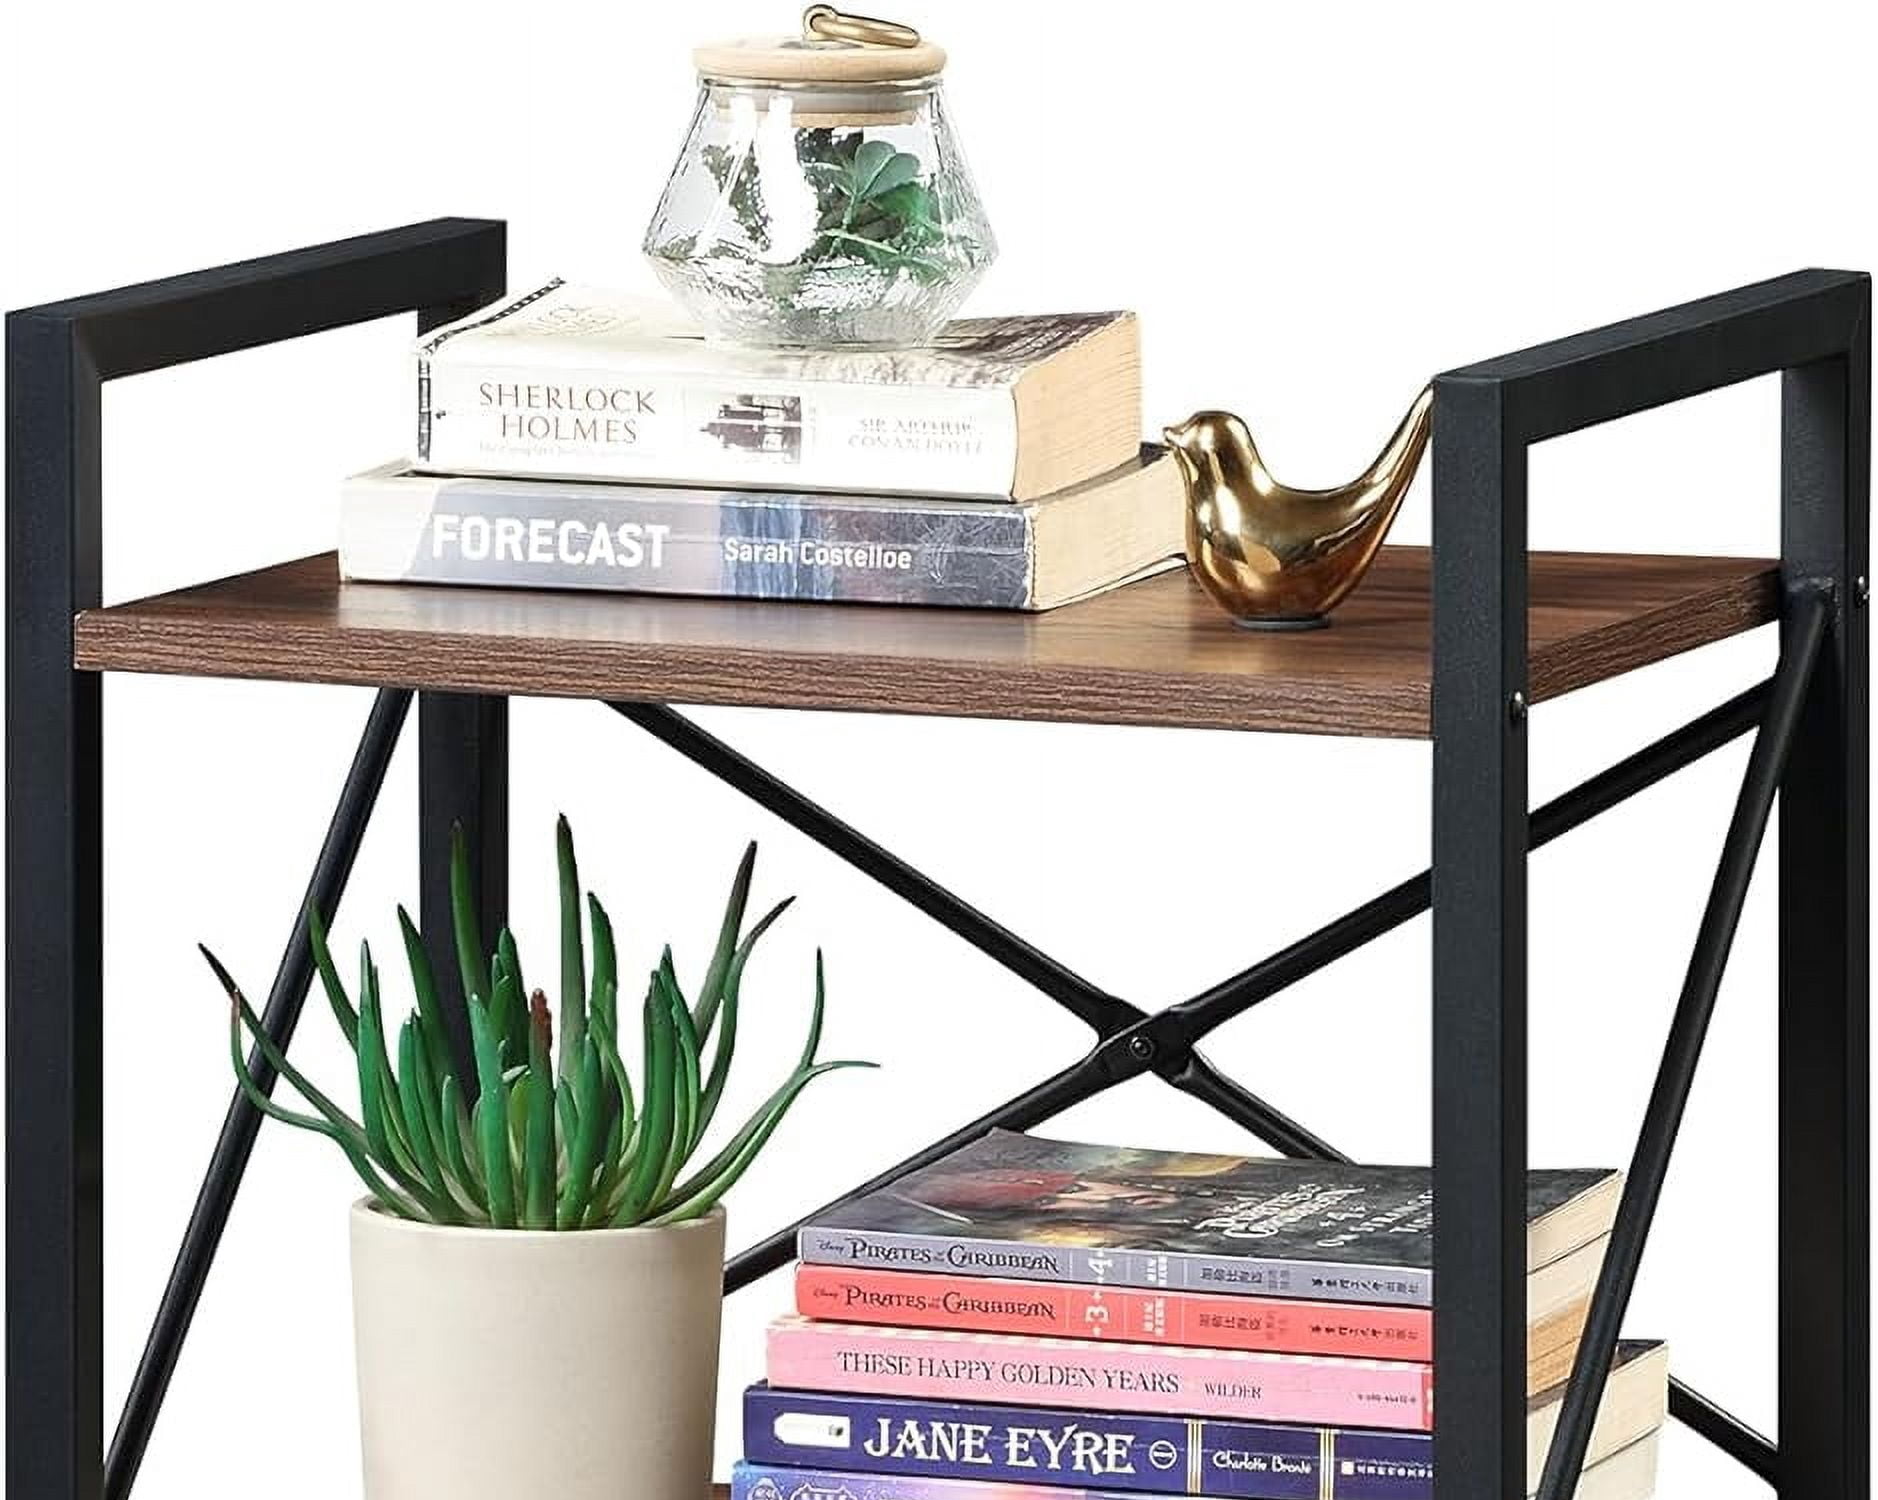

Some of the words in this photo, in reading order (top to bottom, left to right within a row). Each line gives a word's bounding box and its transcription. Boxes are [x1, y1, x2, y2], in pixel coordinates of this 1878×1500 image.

[479, 382, 656, 415] SHERLOCK
[502, 414, 637, 444] HOLMES
[859, 417, 887, 433] SIR
[431, 514, 670, 569] FORECAST
[724, 537, 793, 564] Sarah
[799, 541, 912, 570] Costelloe
[845, 1237, 931, 1263] PIRATES
[947, 1244, 1060, 1274] CARIBBEAN
[839, 1284, 927, 1310] PIRATES
[942, 1291, 1056, 1320] CARIBBEAN
[837, 1351, 912, 1376] THESE
[918, 1357, 994, 1381] HAPPY
[1001, 1362, 1096, 1388] GOLDEN
[1103, 1369, 1179, 1393] YEARS
[1204, 1382, 1262, 1399] WILDER
[863, 1417, 993, 1465] JANE
[1006, 1423, 1137, 1476] EYRE
[1212, 1450, 1267, 1472] Charlotte
